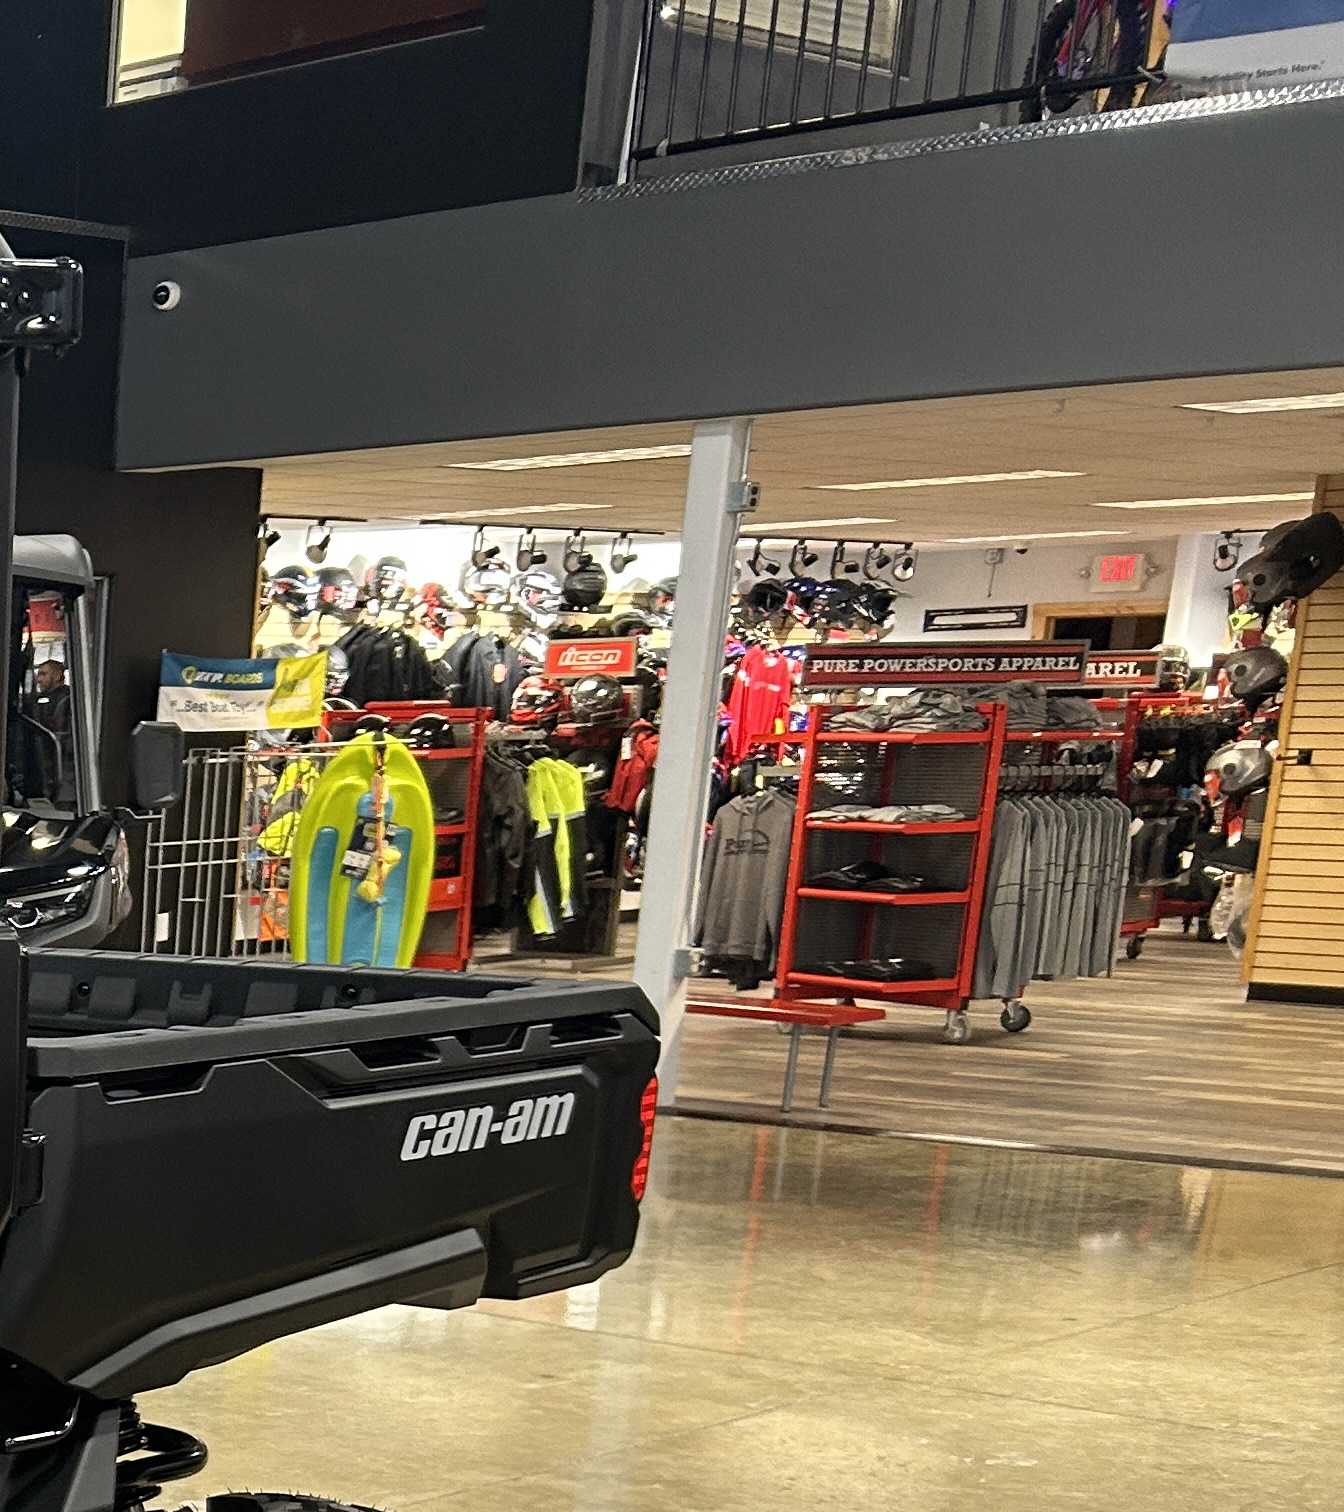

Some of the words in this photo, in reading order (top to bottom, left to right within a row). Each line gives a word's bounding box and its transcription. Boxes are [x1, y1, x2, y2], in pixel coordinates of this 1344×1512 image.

[1100, 555, 1138, 582] EXIT
[811, 659, 859, 673] PURE
[862, 657, 995, 673] POWERSPORTS
[998, 656, 1080, 671] APPAREL
[400, 1092, 575, 1162] can-am
